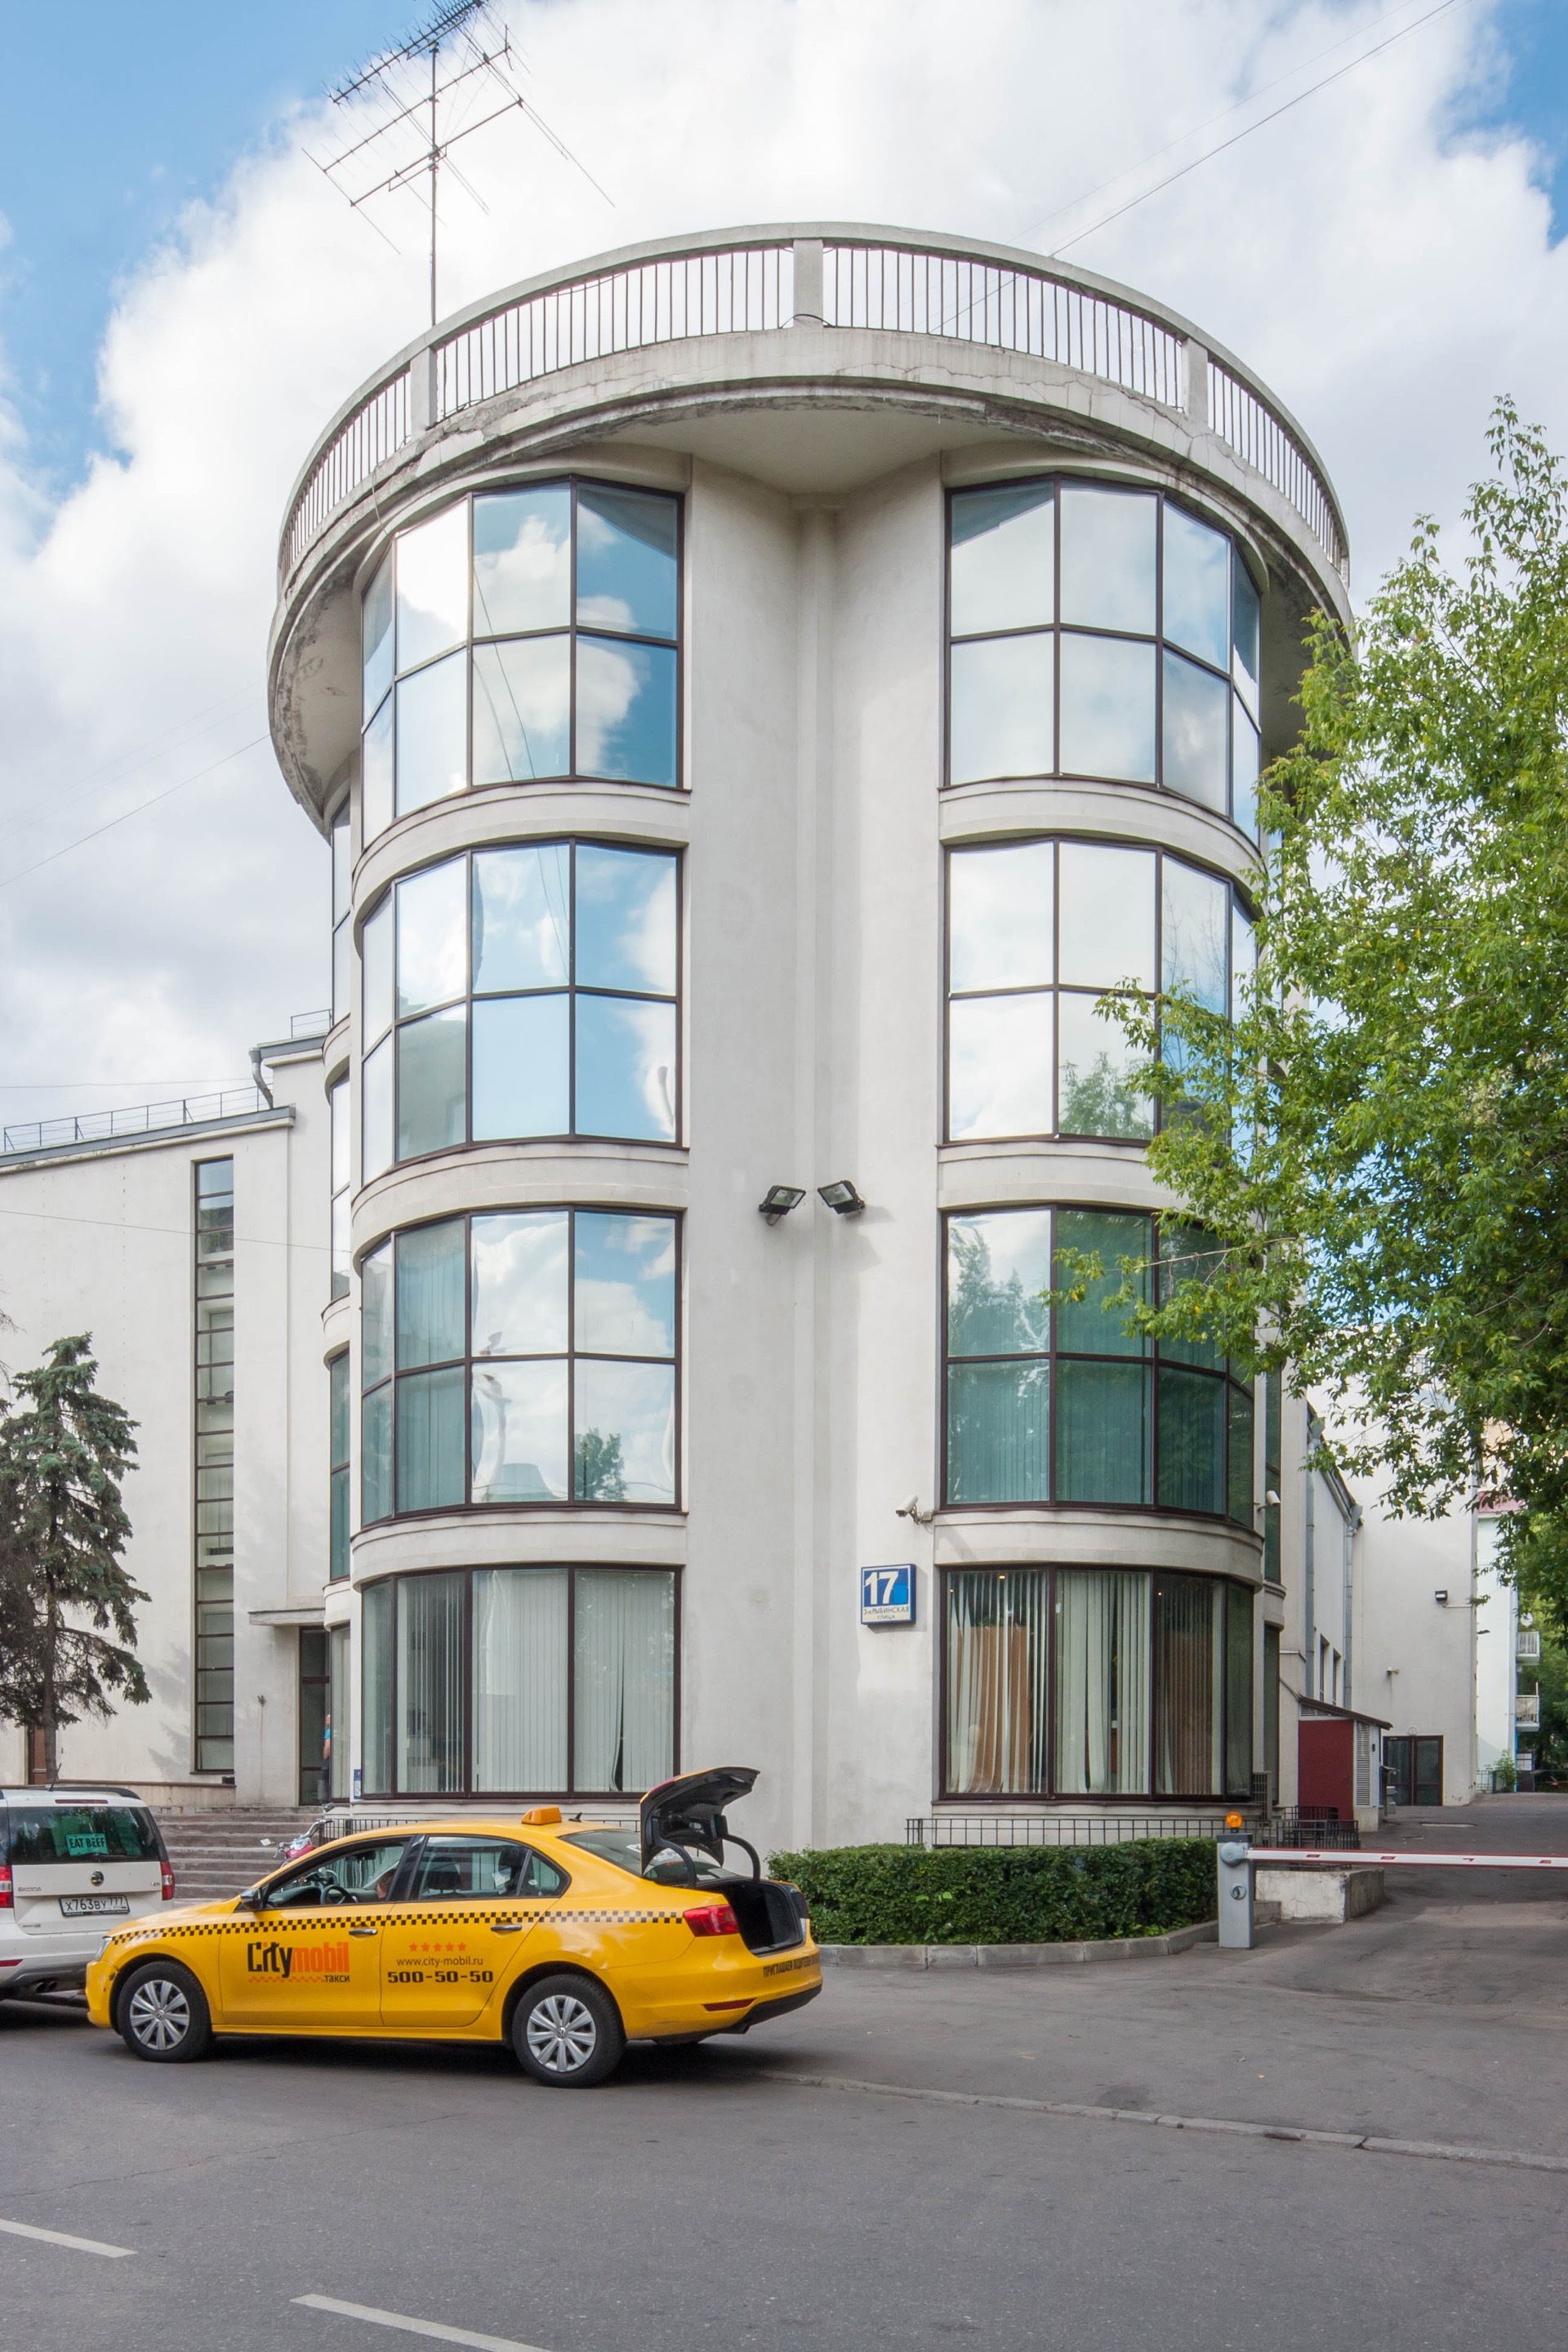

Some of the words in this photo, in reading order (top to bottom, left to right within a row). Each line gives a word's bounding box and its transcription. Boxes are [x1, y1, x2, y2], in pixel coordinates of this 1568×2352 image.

[863, 1570, 899, 1606] 17
[69, 1838, 83, 1848] EAT
[85, 1838, 105, 1847] BEEF
[396, 1956, 483, 1968] www.city-mobil.ru
[324, 1975, 350, 1983] такси
[387, 1970, 494, 1984] 500-50-50
